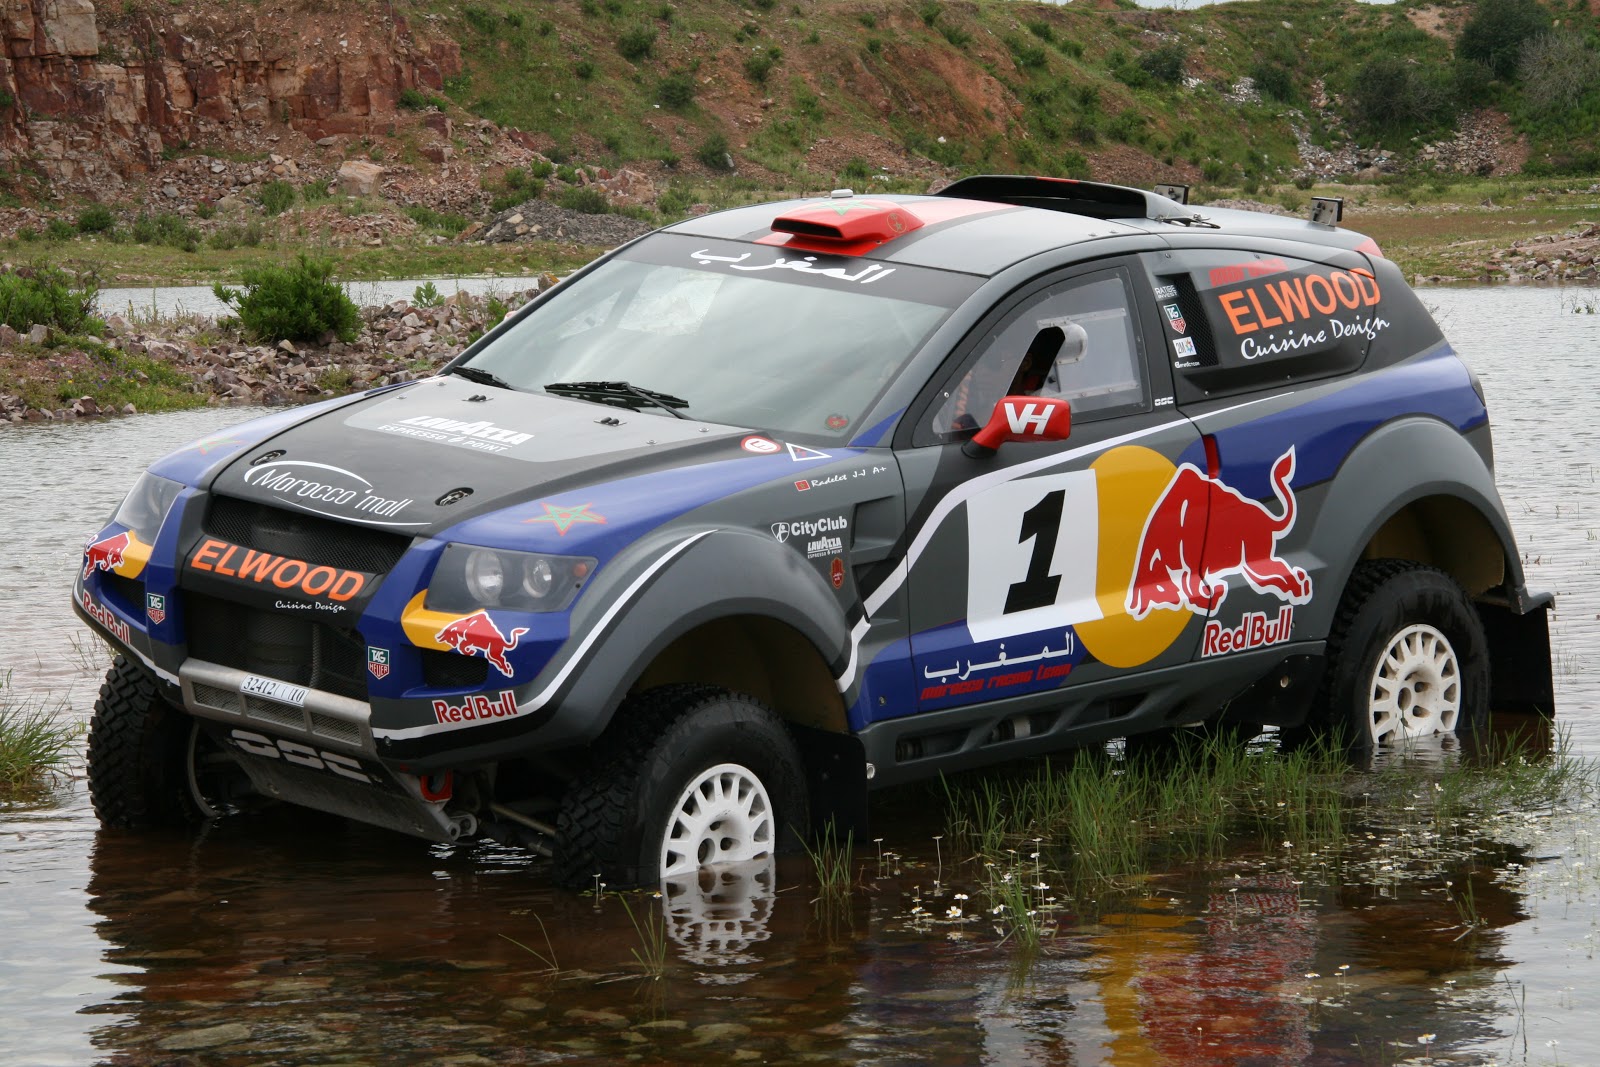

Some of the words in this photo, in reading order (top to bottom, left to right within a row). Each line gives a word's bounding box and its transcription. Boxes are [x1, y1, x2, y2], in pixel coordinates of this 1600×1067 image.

[691, 249, 896, 284] المغرب
[1218, 268, 1381, 335] ELWOOD
[1240, 329, 1327, 360] Cuisine
[1329, 314, 1390, 341] Design
[398, 415, 535, 446] LAVAZZA
[1003, 402, 1056, 435] VH
[377, 424, 447, 441] ESPRESSO
[462, 440, 509, 453] POINT
[253, 471, 356, 505] Morocco
[790, 516, 848, 537] CityClub
[807, 536, 842, 552] LAVAZZA
[1002, 489, 1067, 615] 1
[191, 540, 364, 602] ELWOOD
[149, 595, 162, 609] TAG
[275, 600, 312, 610] Cuisine
[315, 601, 347, 613] Design
[369, 663, 388, 677] HEUER
[371, 649, 386, 663] TAG
[924, 632, 1074, 684] المغرب
